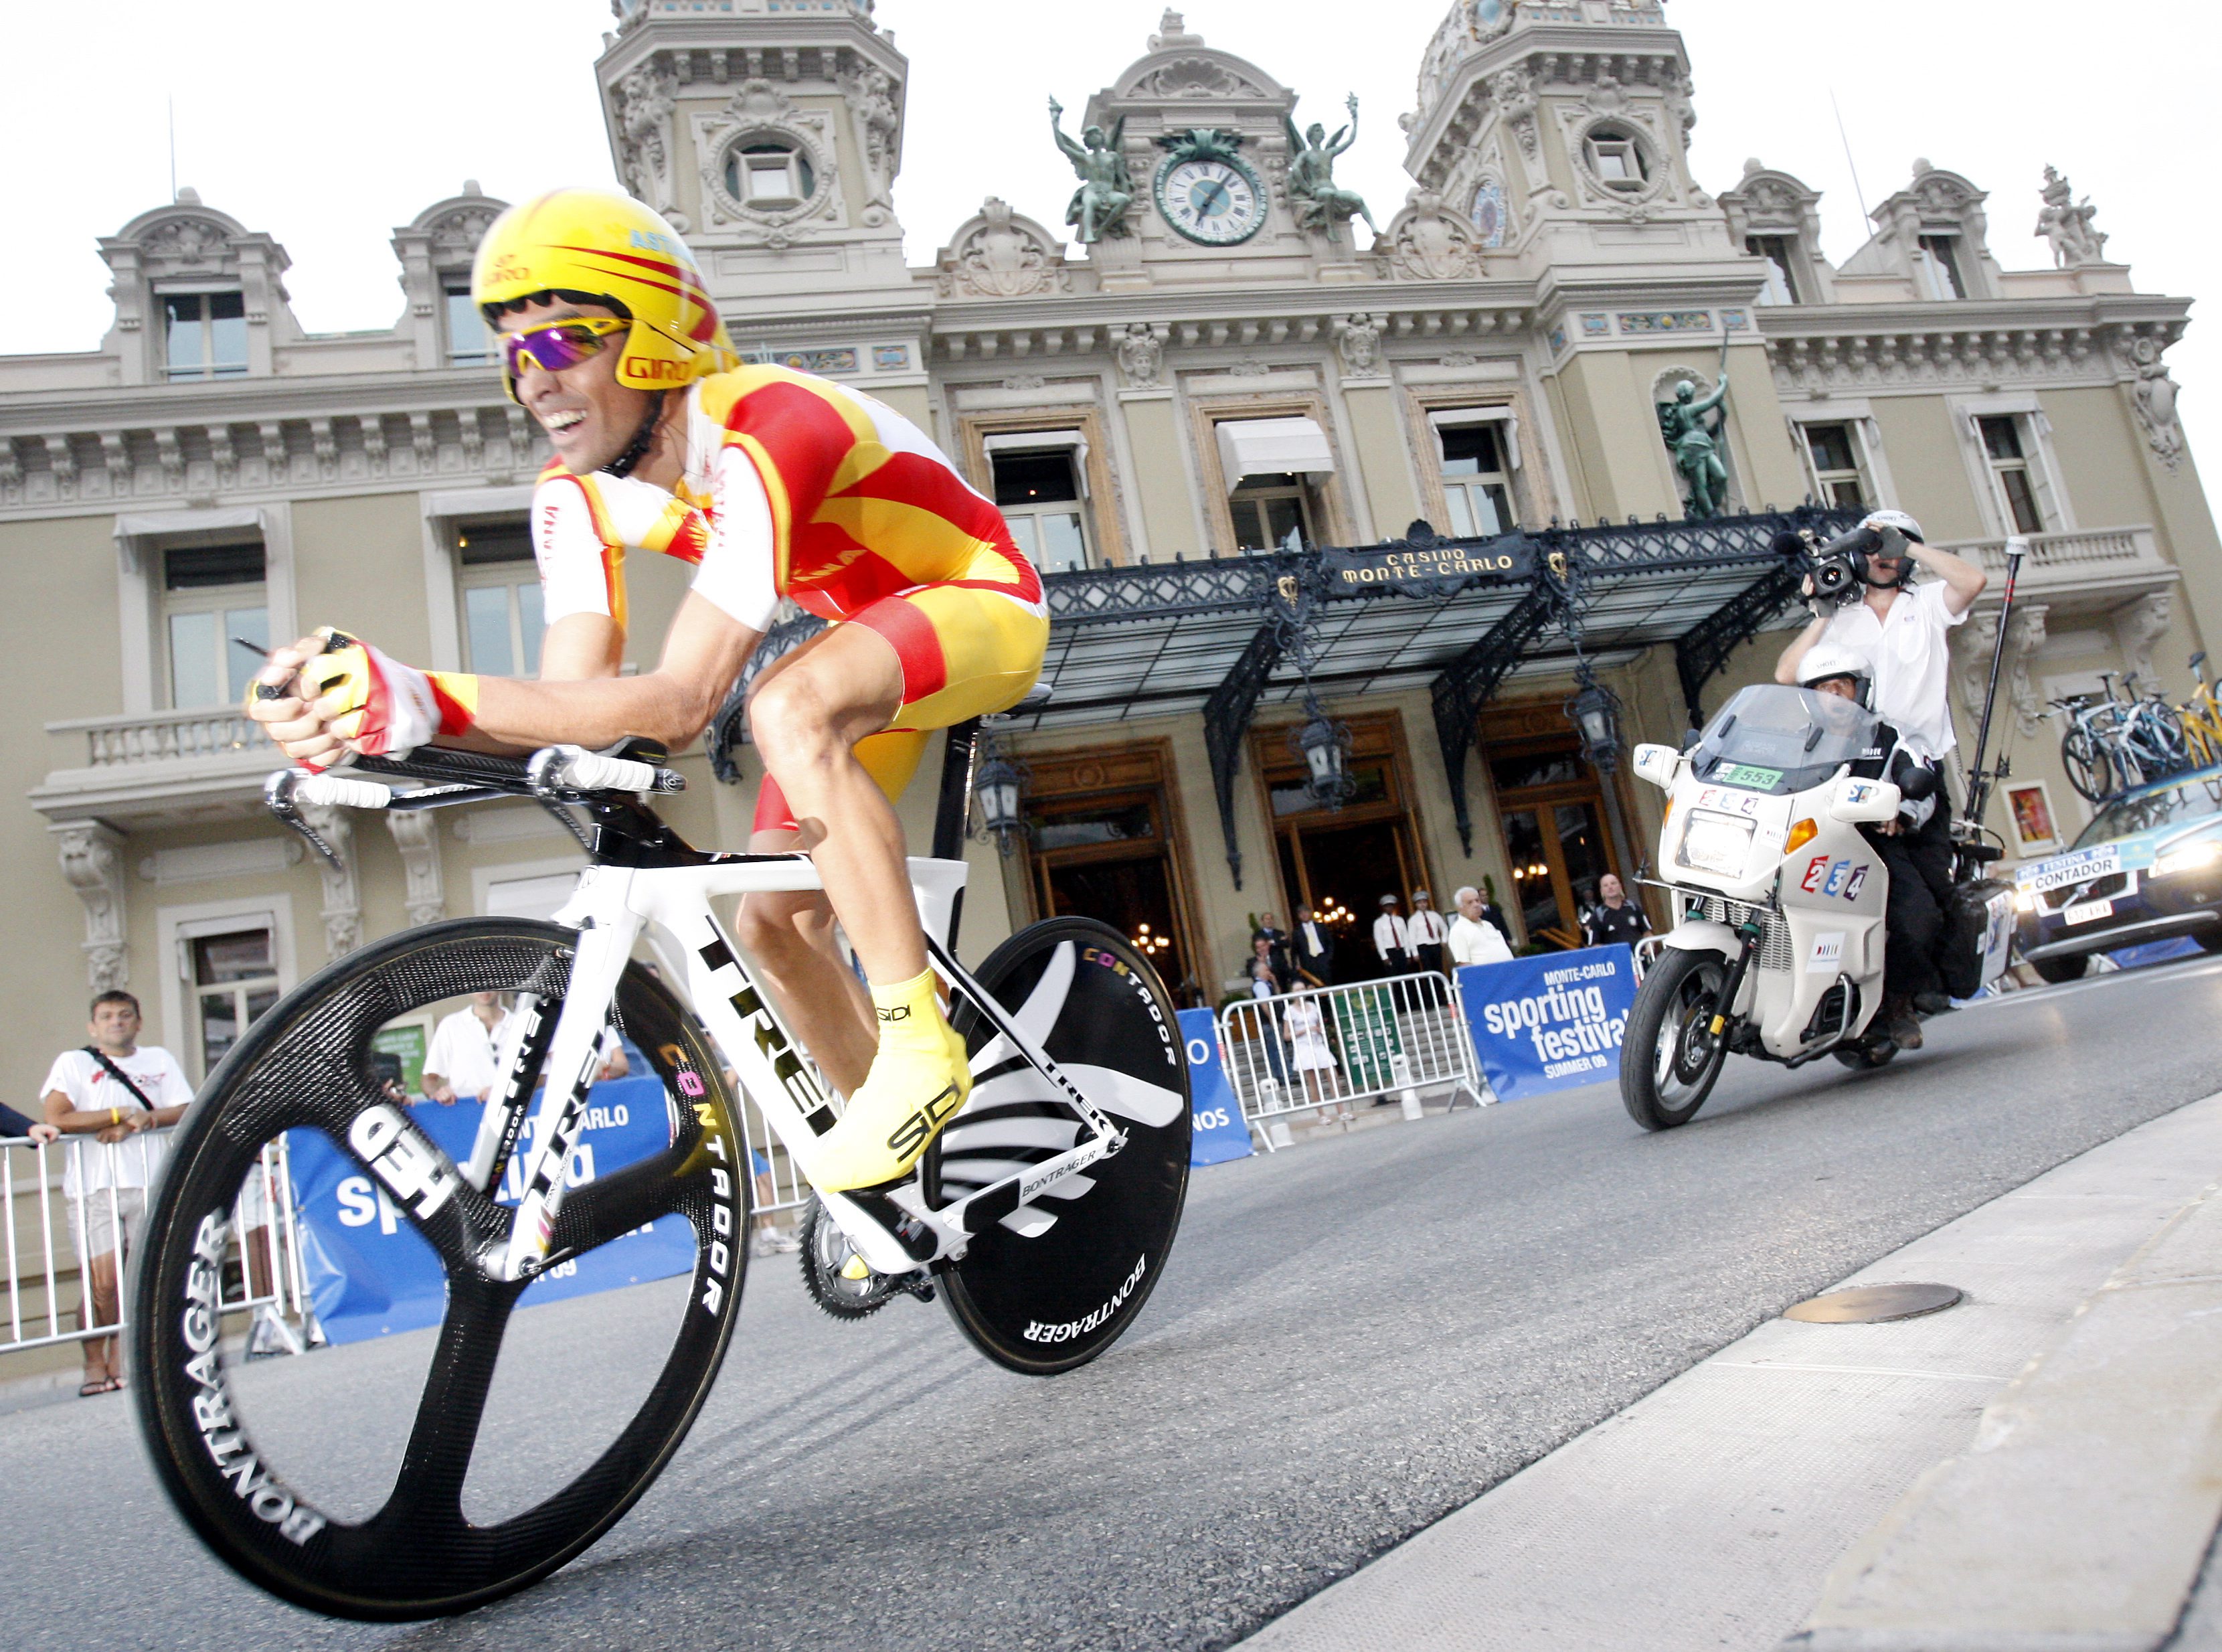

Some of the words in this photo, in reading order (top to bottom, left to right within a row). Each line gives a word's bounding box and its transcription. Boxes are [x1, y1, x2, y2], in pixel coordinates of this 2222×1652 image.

[1342, 555, 1513, 584] MONTE-CARLO
[1386, 548, 1465, 566] CASINO
[1740, 770, 1776, 784] 553
[1804, 865, 1824, 888] 2
[1828, 868, 1847, 892] 3
[1847, 874, 1863, 898] 4
[2035, 859, 2112, 889] CONTADOR
[1544, 961, 1616, 986] MONTE-CARLO
[876, 1005, 911, 1022] SIDI
[1082, 947, 1177, 1066] CONTADOR
[1484, 984, 1607, 1040] sporting
[497, 1005, 545, 1118] TRE
[1544, 1057, 1592, 1079] SUMMER
[1592, 1054, 1608, 1069] 09
[1044, 1056, 1109, 1133] TREK
[351, 1104, 462, 1221] HED
[1022, 1150, 1096, 1197] BONTRAGER
[657, 1043, 732, 1318] CONTADOR
[1023, 1252, 1146, 1343] BONTRAGER
[183, 1208, 327, 1547] BONTRAGER
